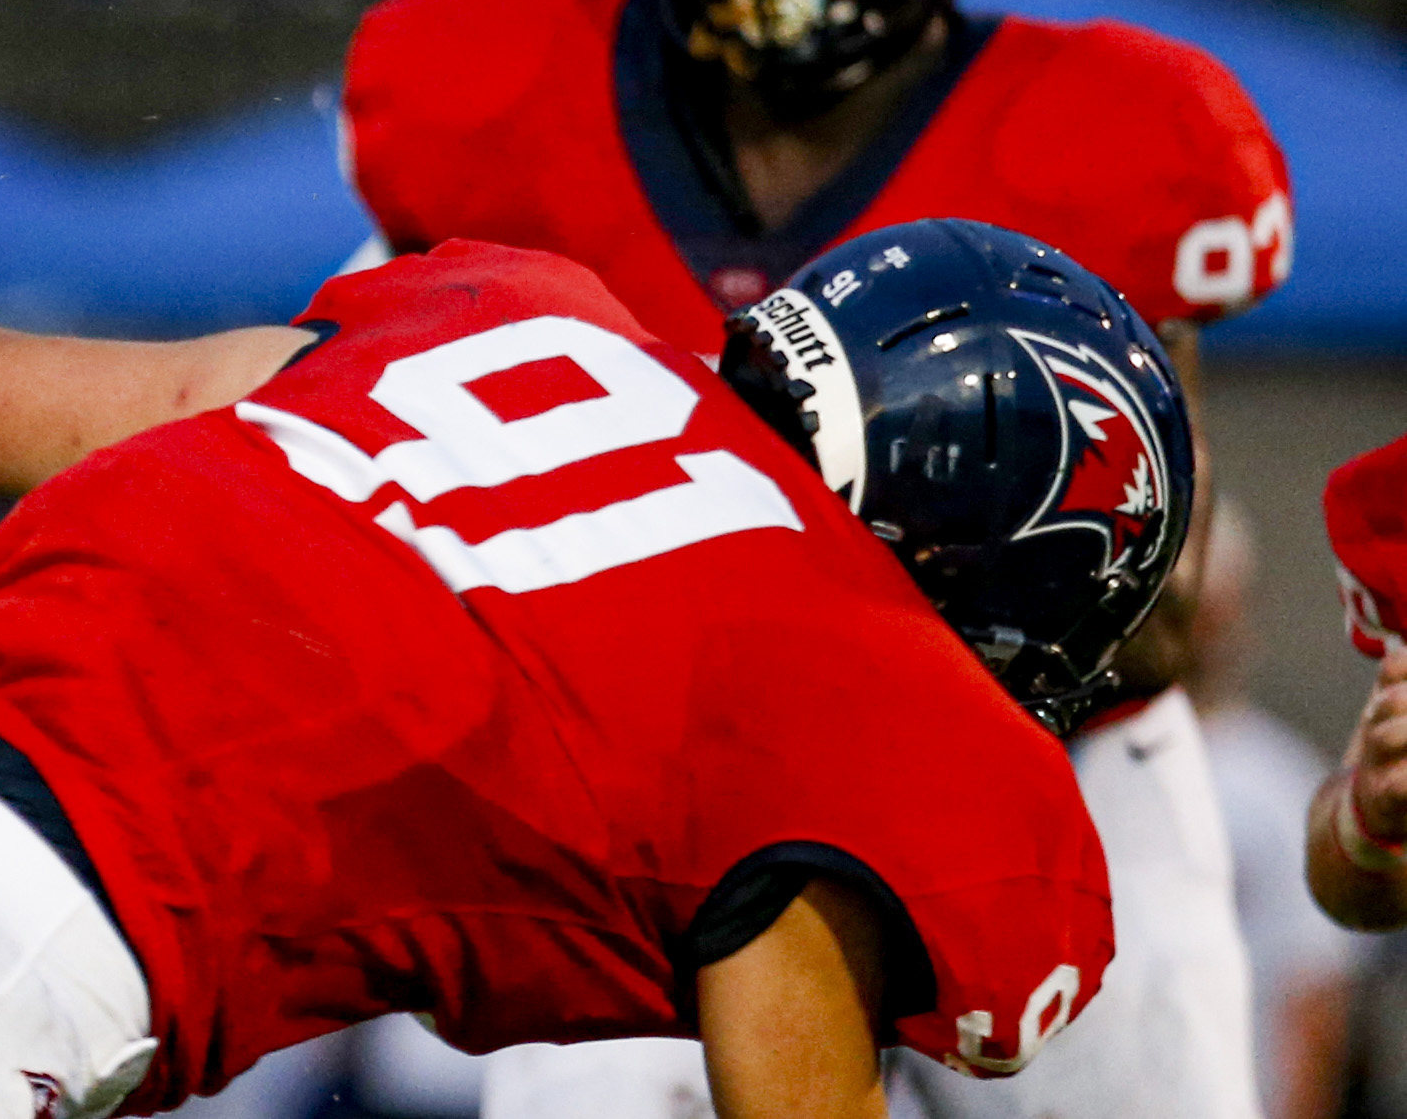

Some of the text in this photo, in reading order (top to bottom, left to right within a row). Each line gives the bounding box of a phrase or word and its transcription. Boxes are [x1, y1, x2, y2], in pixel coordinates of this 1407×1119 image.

[821, 269, 863, 308] 91
[758, 295, 836, 371] schutt
[236, 314, 805, 594] 91
